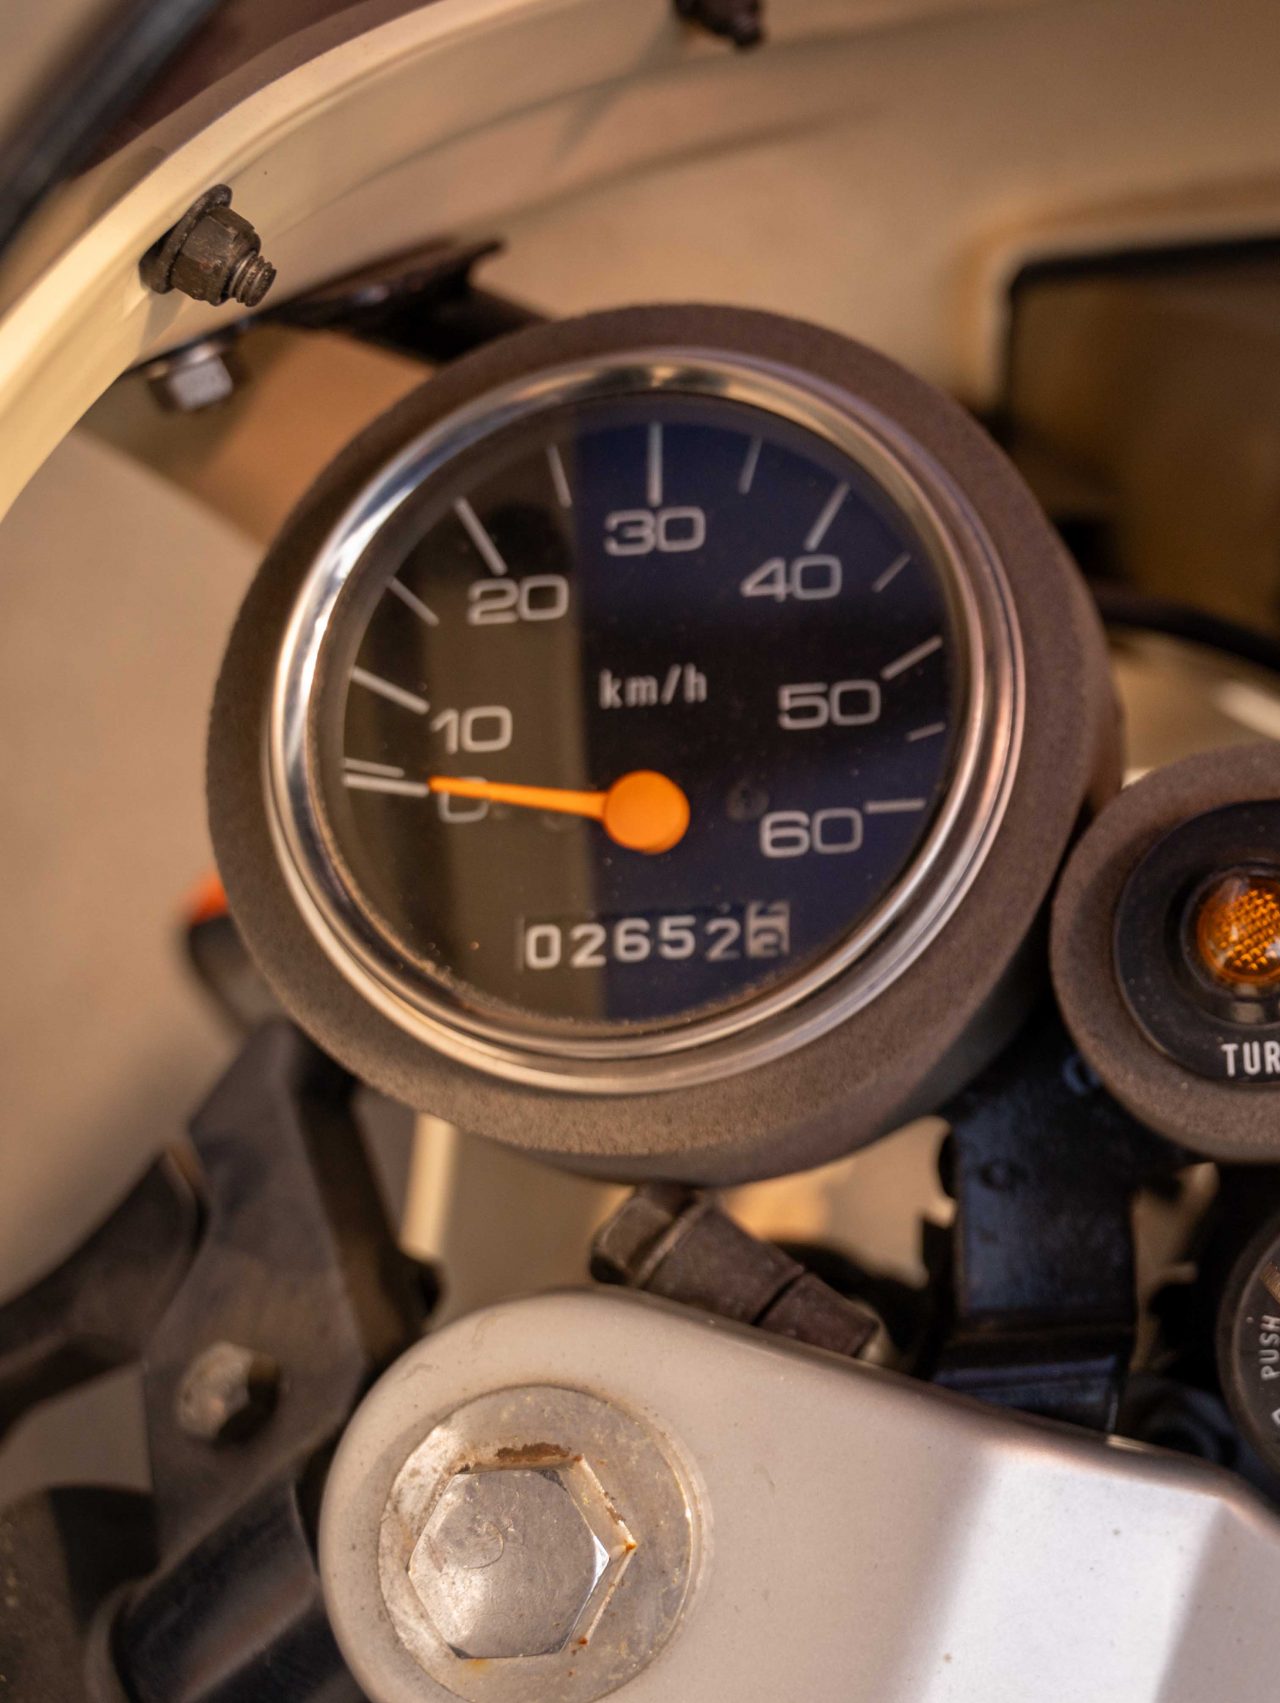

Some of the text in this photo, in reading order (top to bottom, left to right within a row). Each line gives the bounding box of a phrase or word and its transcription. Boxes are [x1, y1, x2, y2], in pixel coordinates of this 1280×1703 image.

[604, 507, 706, 555] 30
[467, 574, 569, 625] 20
[740, 555, 842, 602] 40
[600, 663, 707, 708] km/h
[778, 679, 882, 729] 50
[430, 706, 512, 754] 10
[759, 807, 863, 858] 60
